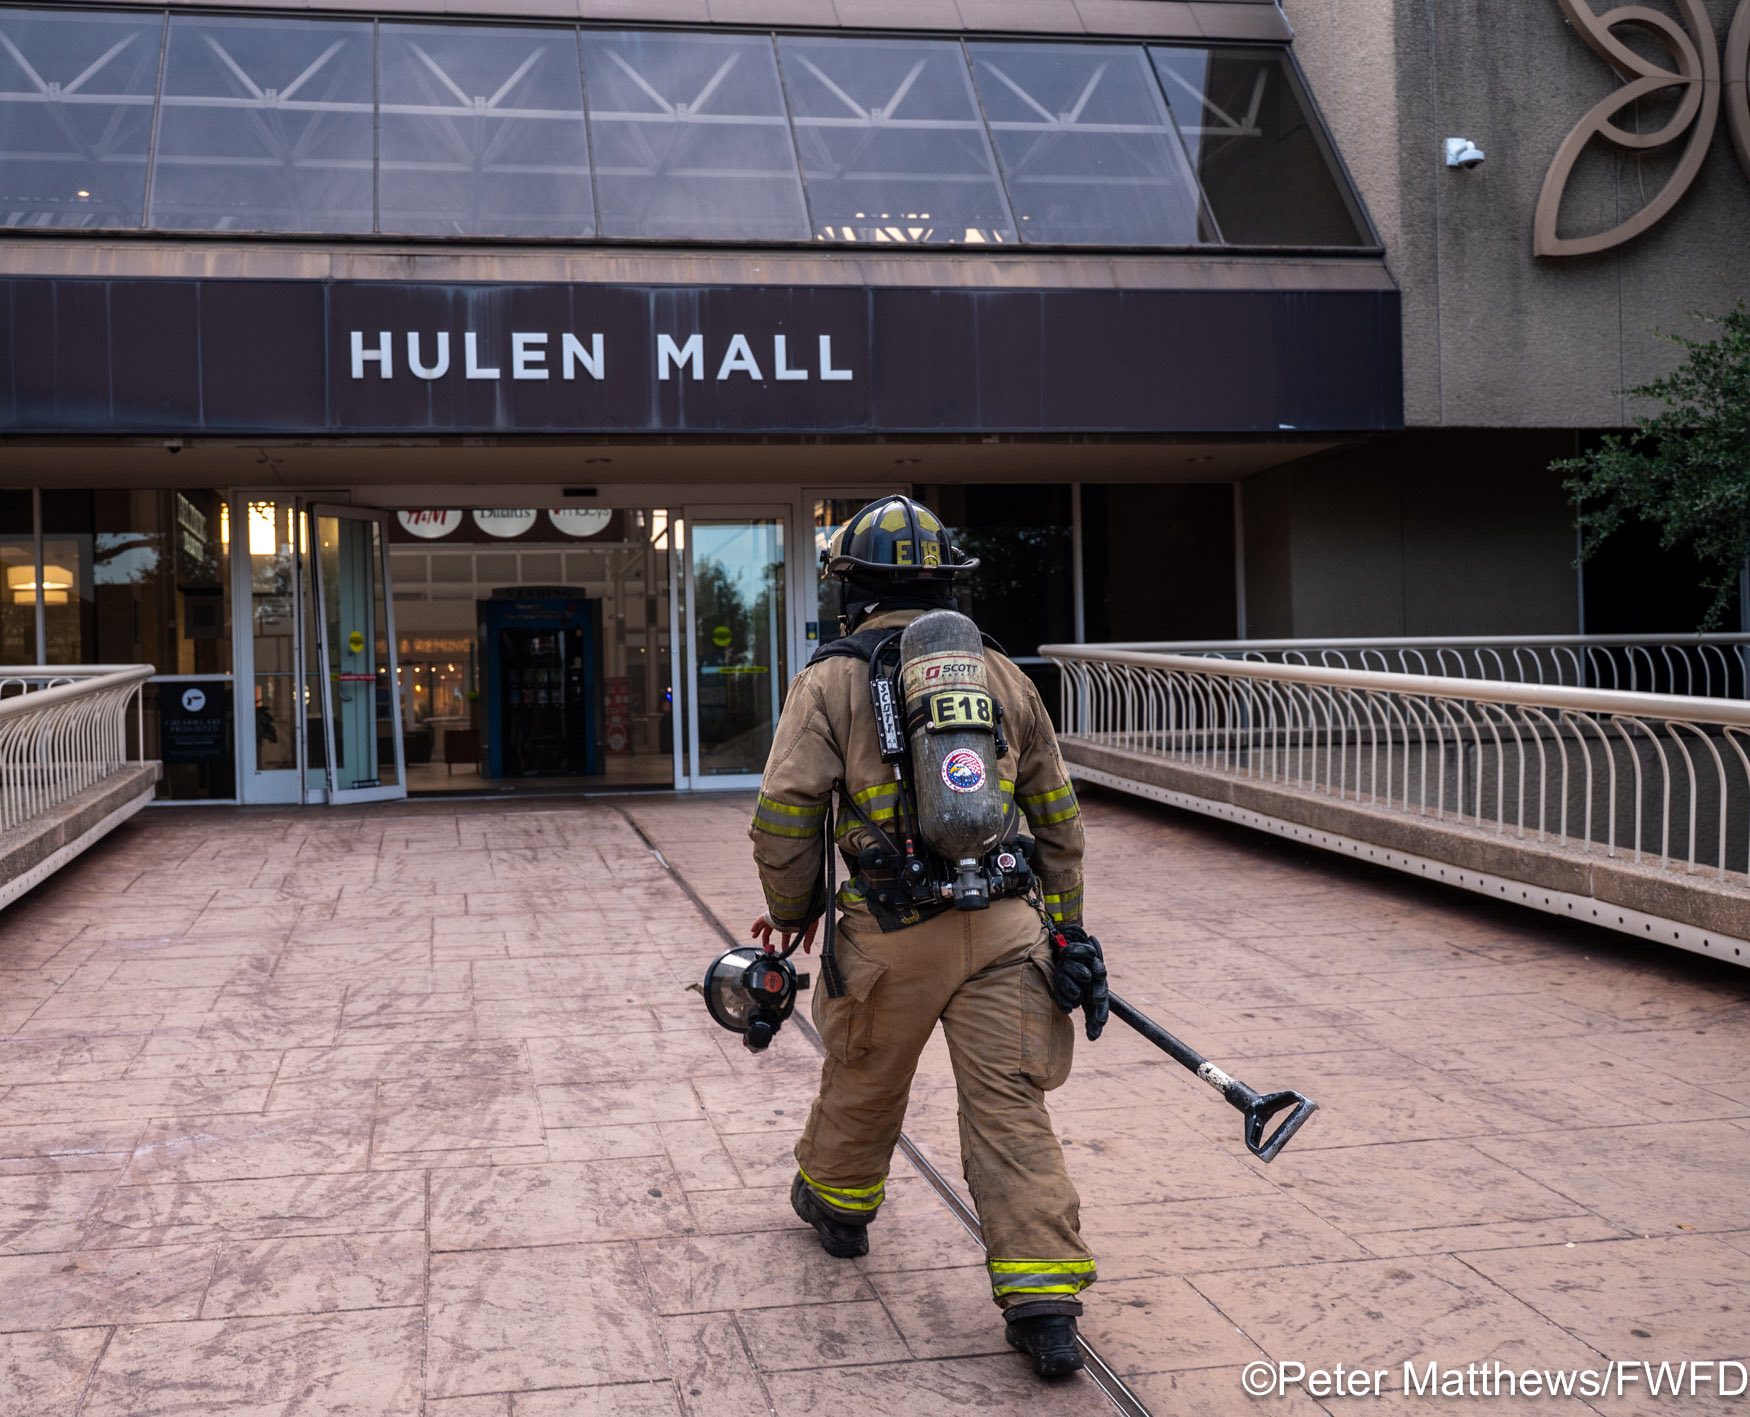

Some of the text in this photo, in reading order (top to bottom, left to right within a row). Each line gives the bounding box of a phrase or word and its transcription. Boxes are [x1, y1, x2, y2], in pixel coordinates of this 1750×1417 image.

[350, 331, 854, 381] HULEN MALL
[407, 509, 447, 525] H&M
[480, 509, 531, 519] Dillards
[562, 508, 610, 519] macys
[896, 540, 912, 565] E
[942, 663, 978, 673] SCOTT
[936, 696, 990, 723] E18
